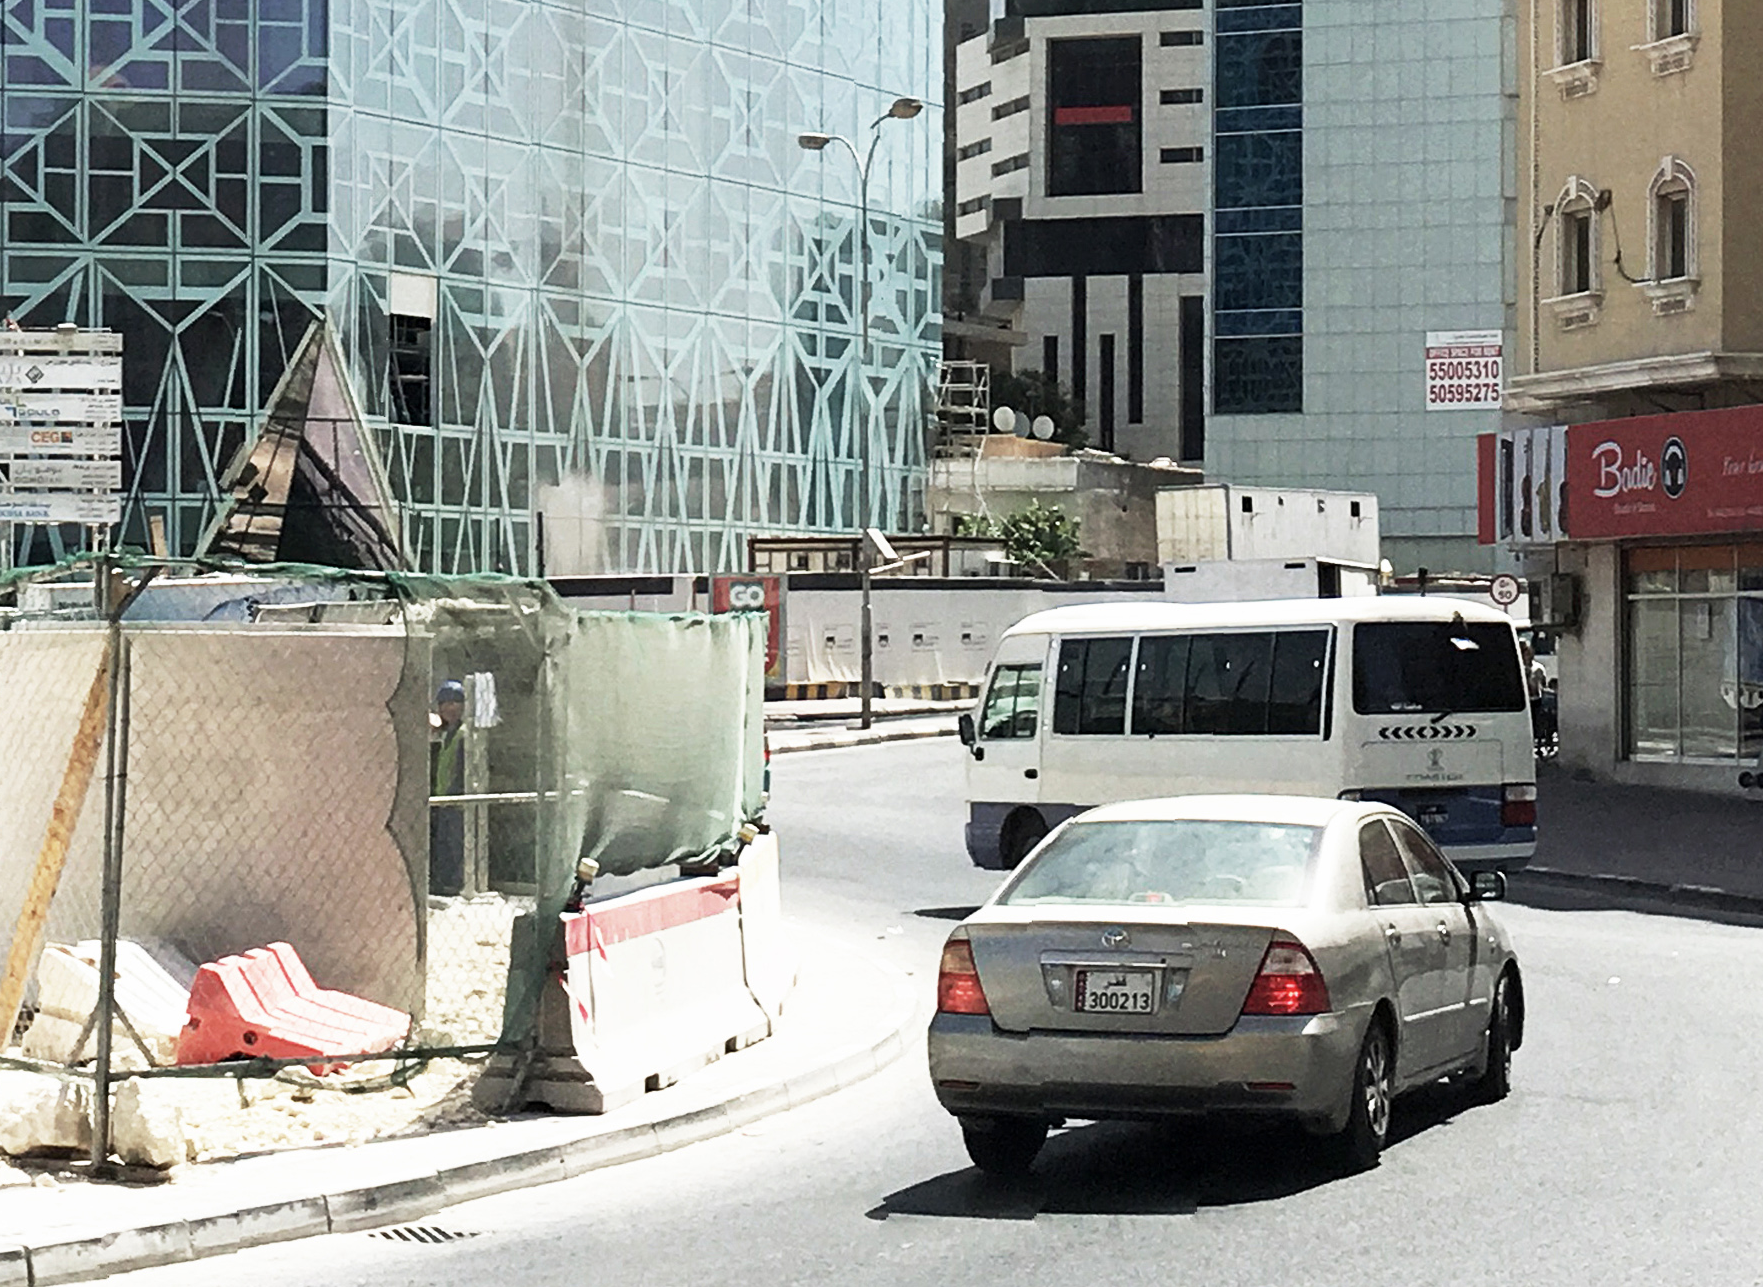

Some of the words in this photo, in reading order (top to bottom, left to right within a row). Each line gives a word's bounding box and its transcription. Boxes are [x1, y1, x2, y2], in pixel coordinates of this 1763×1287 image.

[1429, 360, 1499, 380] 55005310
[1429, 383, 1500, 403] 50595275
[30, 431, 60, 444] CEG
[1592, 441, 1658, 498] Badie
[730, 584, 765, 607] GO
[1089, 992, 1150, 1010] 300213
